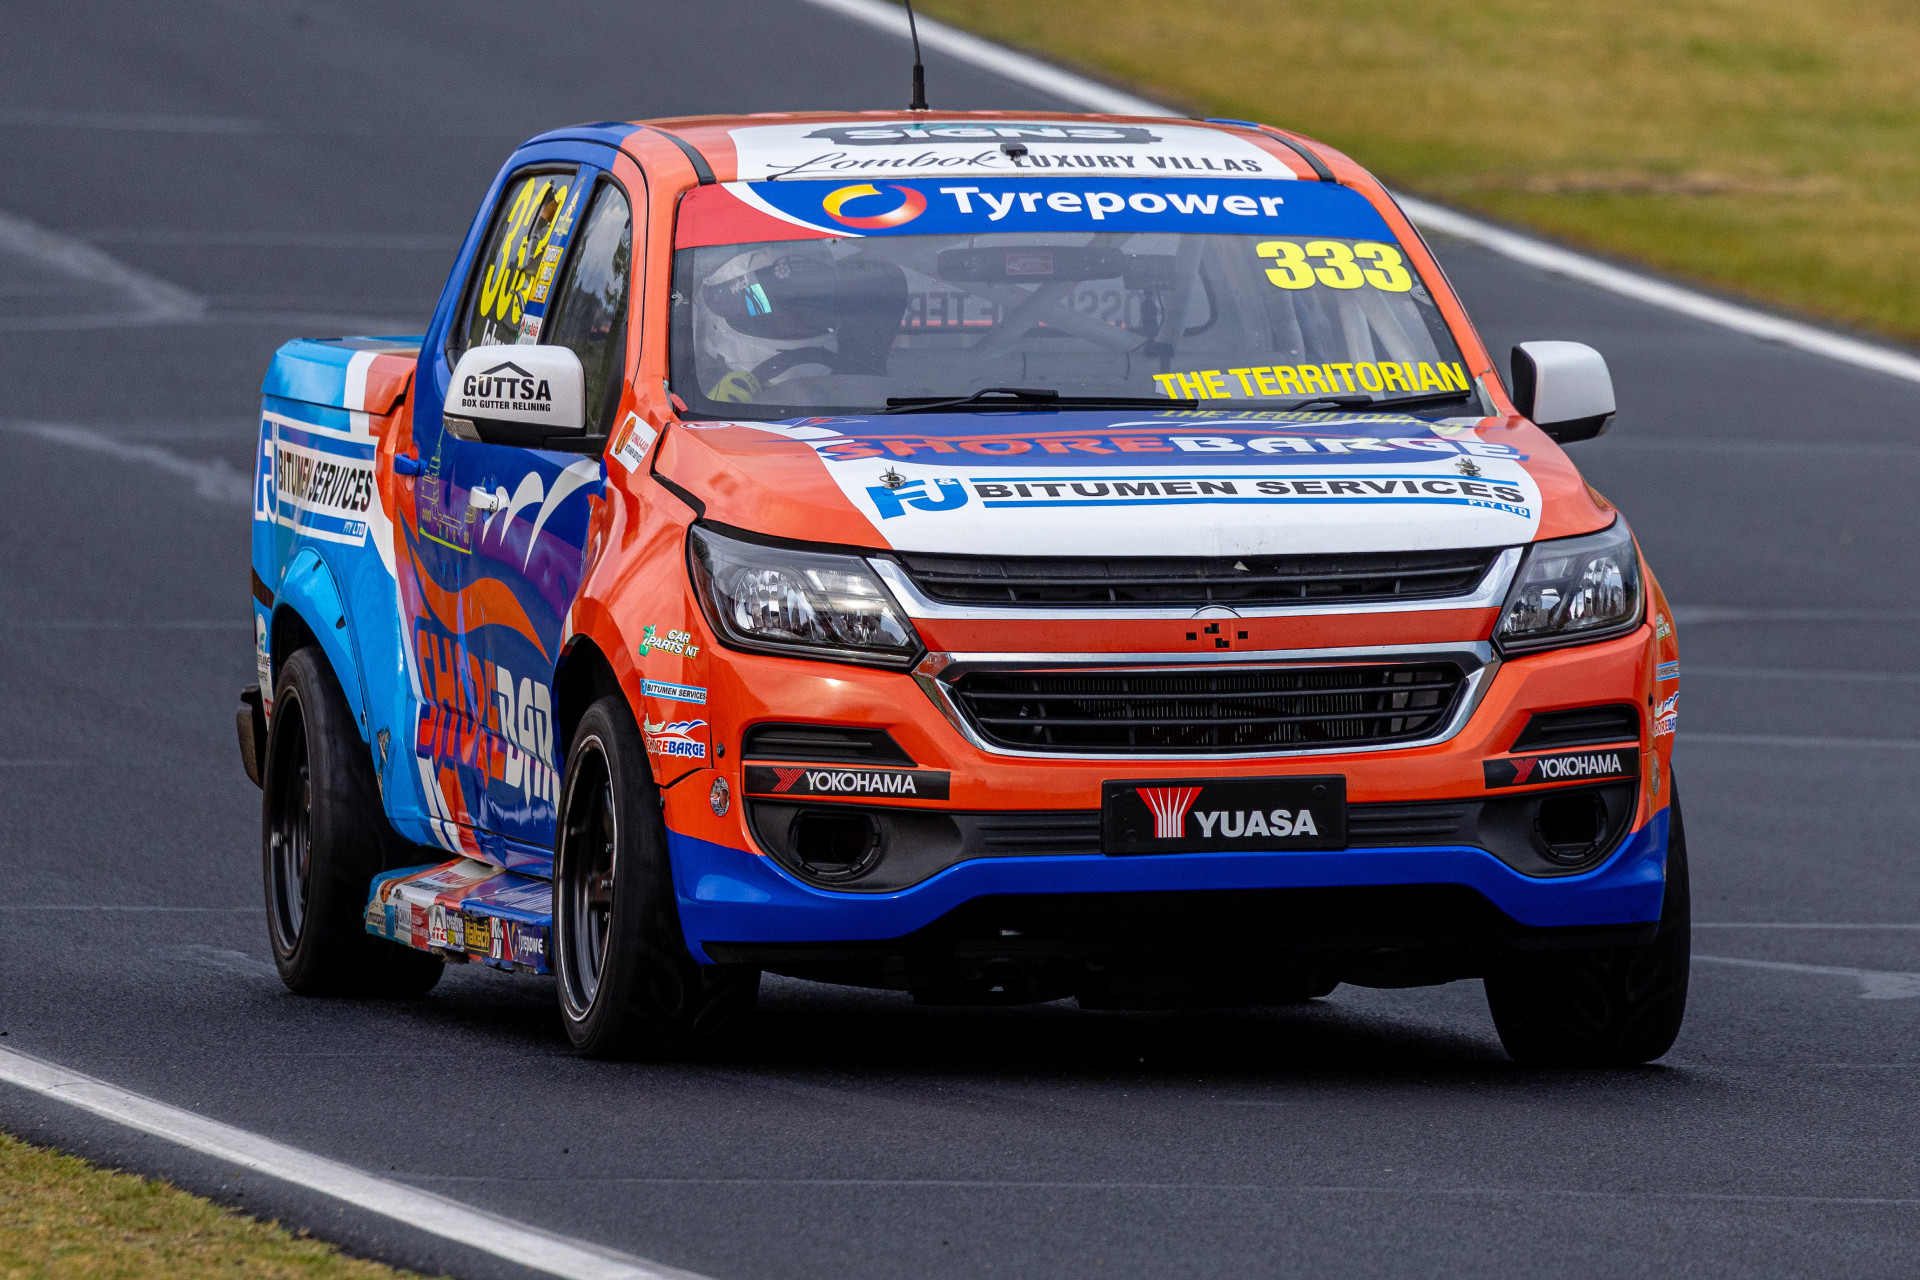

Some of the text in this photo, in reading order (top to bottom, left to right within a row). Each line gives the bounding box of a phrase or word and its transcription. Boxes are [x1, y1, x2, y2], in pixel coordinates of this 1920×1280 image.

[845, 128, 1126, 140] SIGNS
[768, 150, 1263, 174] Lombok LUXURY VILLAS
[940, 186, 1284, 221] Tyrepower
[1256, 241, 1413, 293] 333
[463, 375, 552, 402] GUTTSA
[1153, 362, 1471, 402] THE TERRITORIAN
[462, 398, 551, 412] BOX GUTTER RELINING
[279, 449, 314, 500] BITUMEN
[308, 461, 373, 512] SERVICES
[973, 481, 1239, 498] BITUMEN
[1256, 480, 1525, 503] SERVICES
[1468, 499, 1528, 516] PTY LTD
[352, 523, 365, 536] LTD
[646, 636, 700, 658] PARTS NT
[667, 629, 690, 644] CAR
[647, 683, 677, 696] BITUMEN
[677, 689, 707, 701] SERVICES
[1538, 753, 1622, 778] YOKOHAMA
[805, 771, 917, 794] YOKOHAMA
[1194, 809, 1319, 838] YUASA
[465, 920, 489, 948] Haltech
